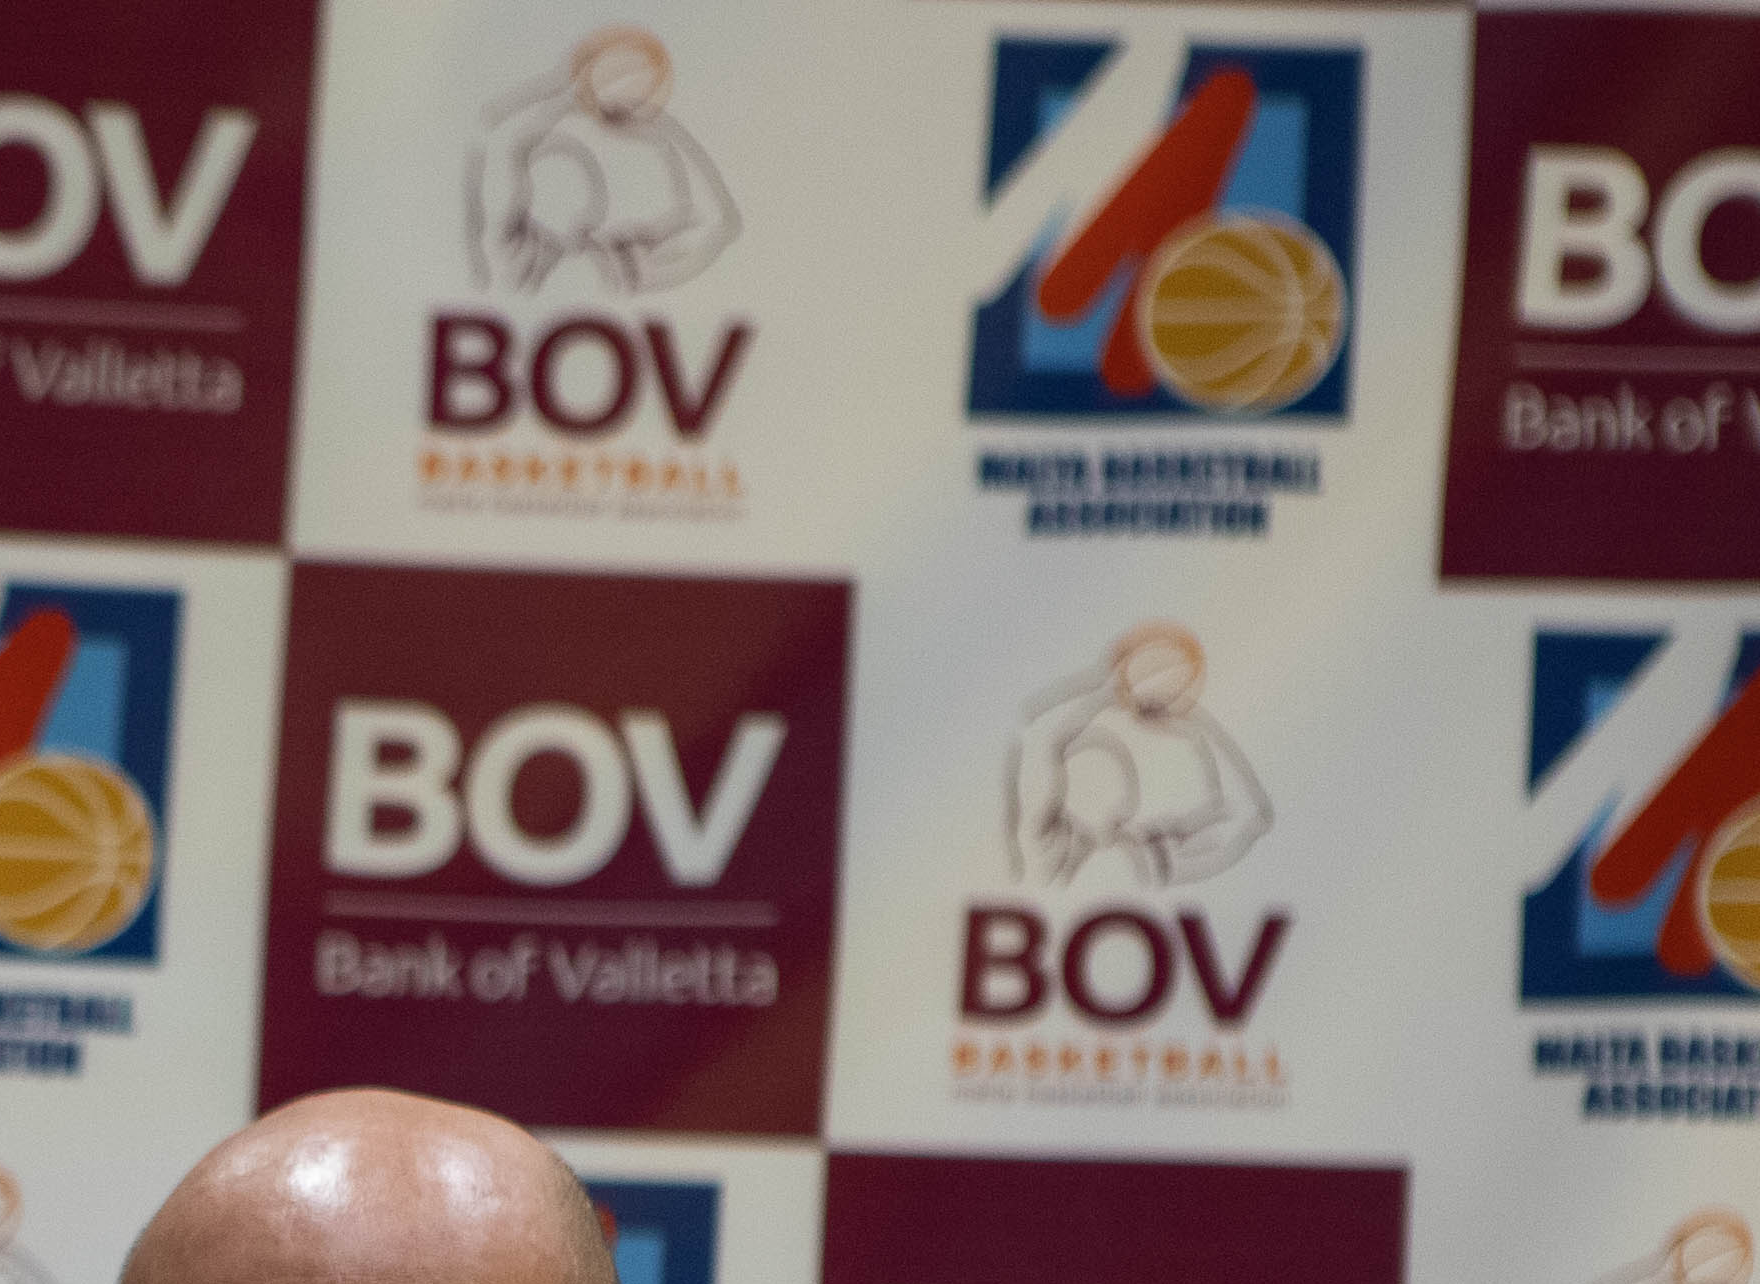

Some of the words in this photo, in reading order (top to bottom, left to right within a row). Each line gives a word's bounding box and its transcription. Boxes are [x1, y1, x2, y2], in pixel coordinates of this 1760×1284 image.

[1518, 143, 1760, 336] BO
[4, 339, 244, 415] Valletta
[427, 313, 754, 443] BOV
[1503, 379, 1654, 450] Bank
[1661, 379, 1734, 453] of
[329, 696, 787, 888] BOV
[315, 928, 464, 998] Bank
[469, 931, 538, 1001] of
[547, 938, 779, 1005] Valletta
[959, 903, 1292, 1025] BOV
